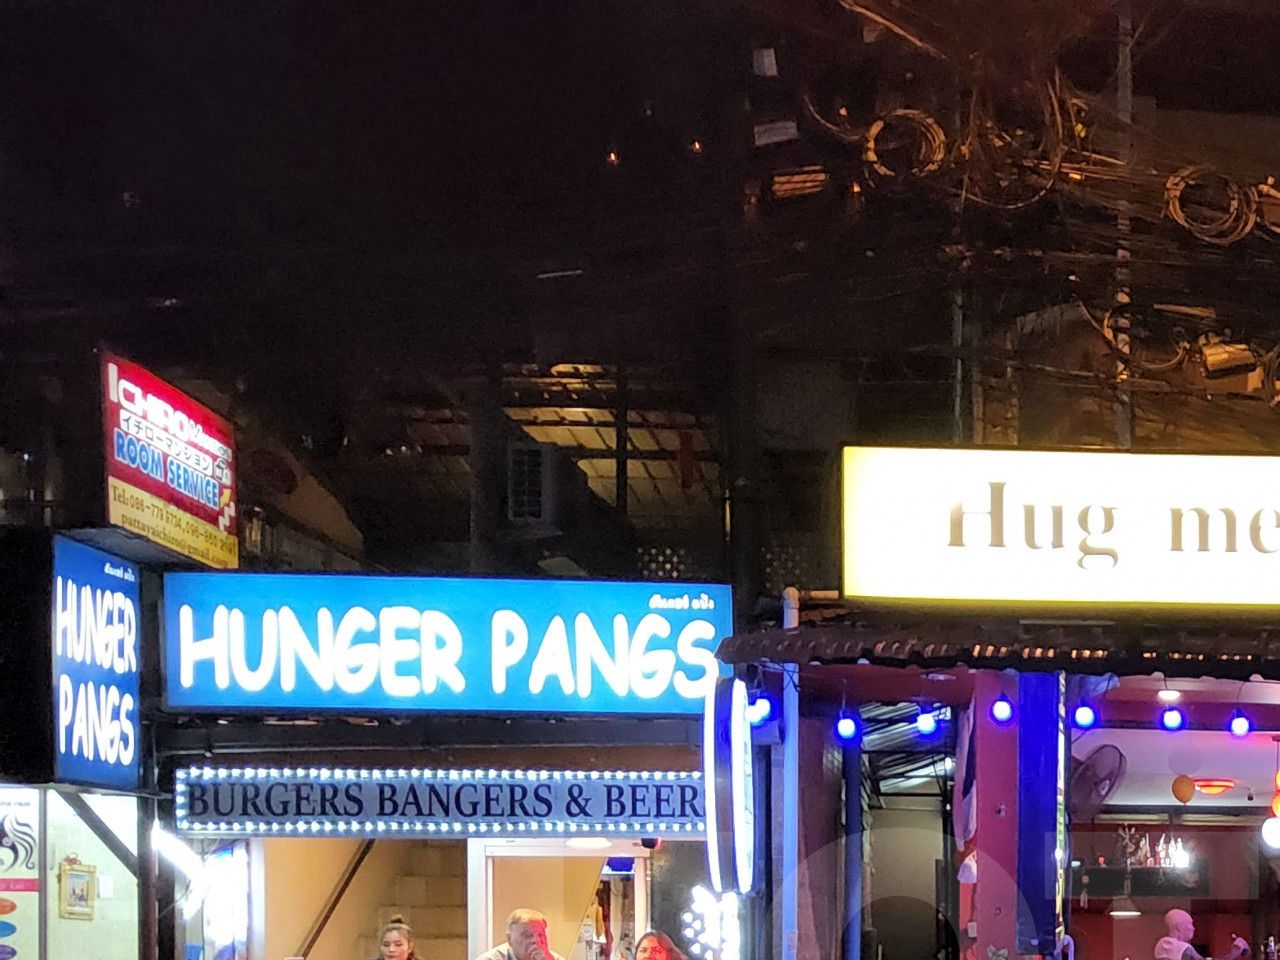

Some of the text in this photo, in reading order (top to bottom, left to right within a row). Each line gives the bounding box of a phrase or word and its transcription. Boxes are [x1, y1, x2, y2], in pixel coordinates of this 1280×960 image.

[114, 428, 219, 510] ROOM SERVICE
[947, 482, 1119, 570] Hug
[56, 575, 137, 674] HUNGER
[179, 604, 718, 699] HUNGER PANGS
[59, 674, 135, 766] PANGS
[187, 784, 364, 818] BURGERS
[376, 784, 553, 818] BANGERS
[565, 784, 592, 818] &
